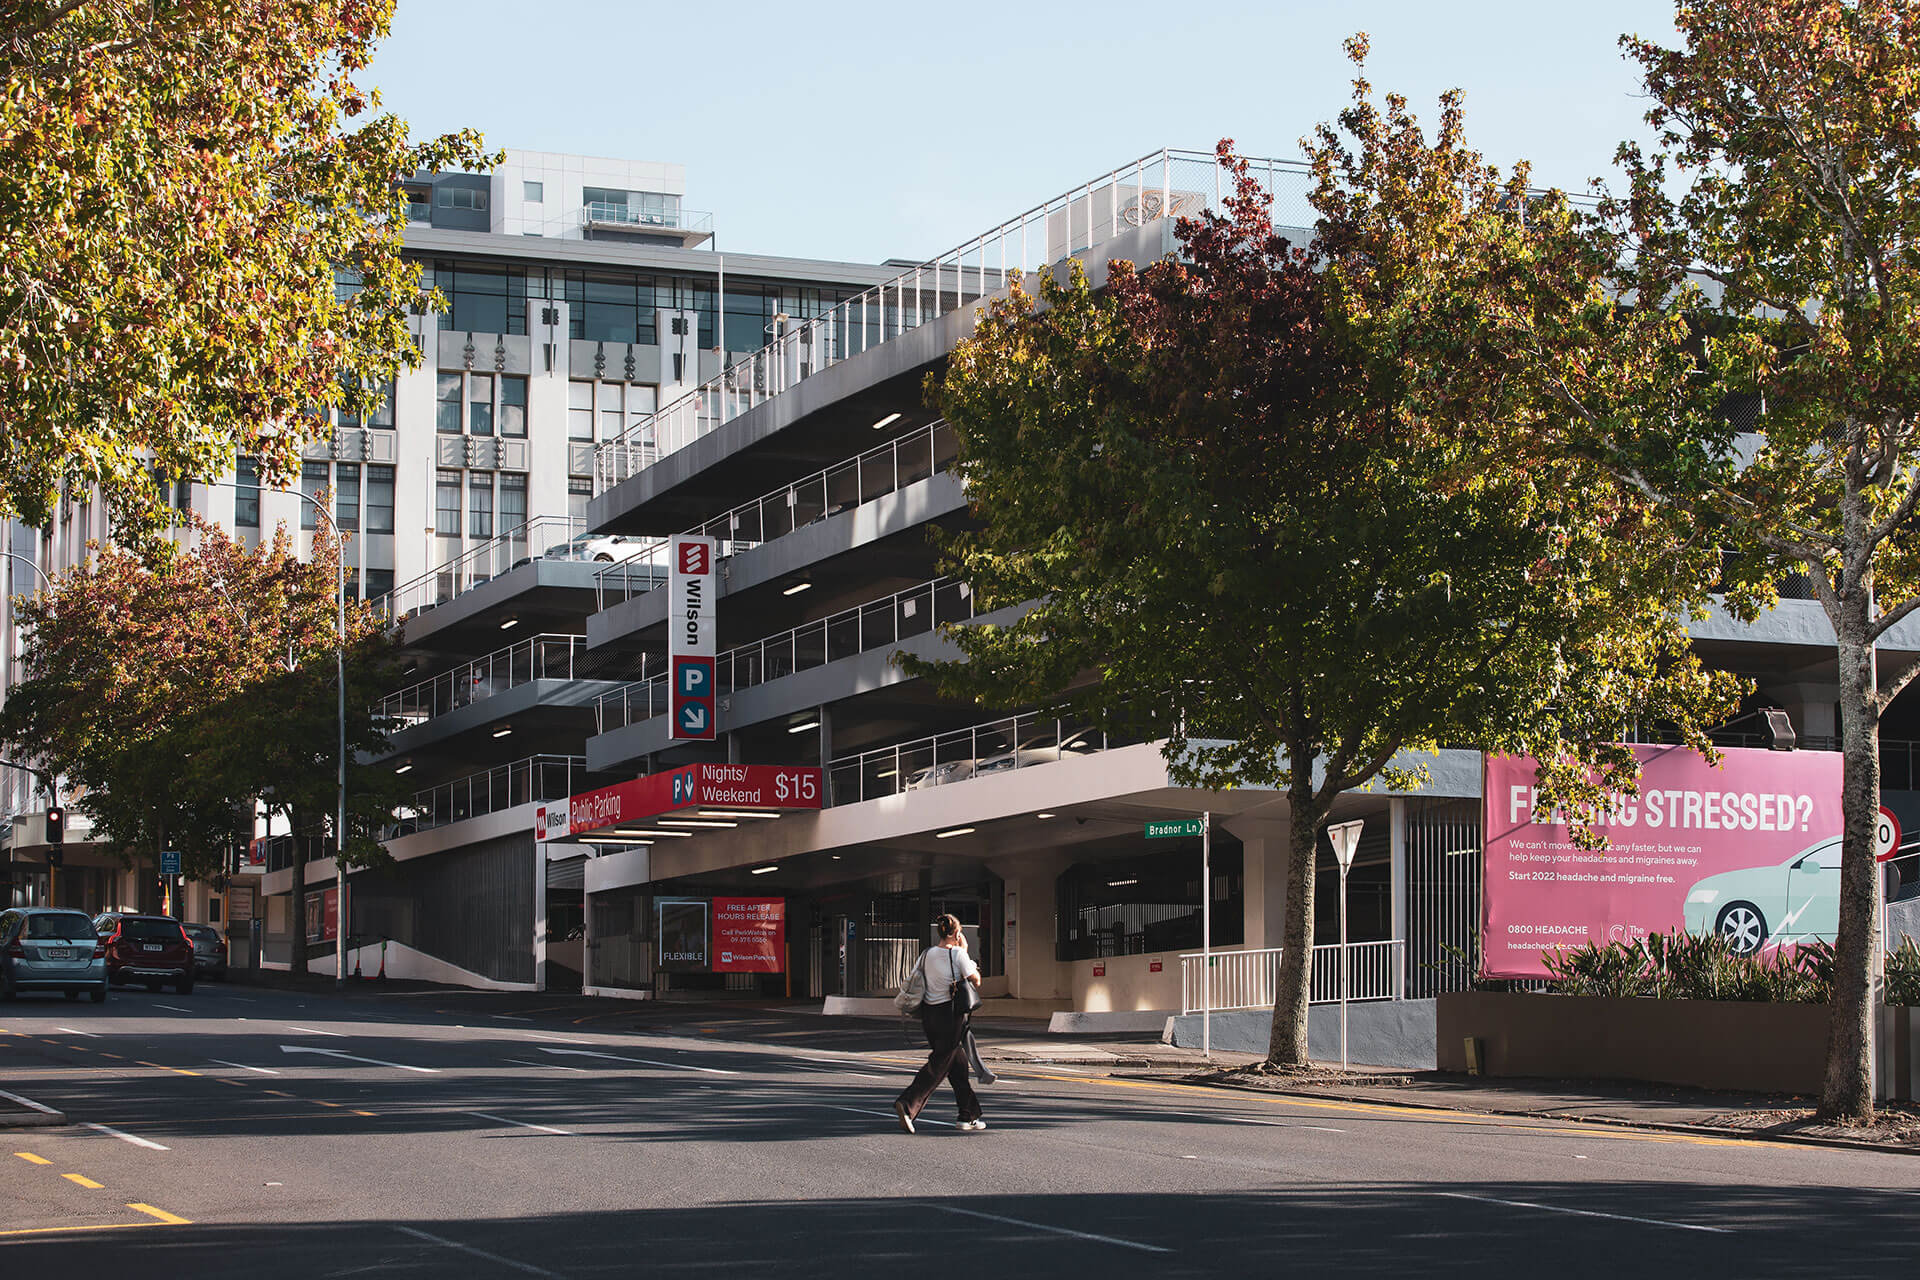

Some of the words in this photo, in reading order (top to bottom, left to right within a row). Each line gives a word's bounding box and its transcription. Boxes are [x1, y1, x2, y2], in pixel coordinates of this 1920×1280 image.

[686, 578, 702, 646] Wilson
[685, 669, 704, 691] P
[702, 765, 748, 782] Nights/
[674, 779, 682, 799] P
[702, 786, 761, 803] Weekend
[775, 772, 816, 801] $15
[571, 800, 593, 826] Public
[594, 792, 621, 819] Parking
[1645, 789, 1814, 832] STRESSED?
[546, 811, 567, 828] Wilson
[1149, 825, 1181, 836] Bradnor
[1186, 823, 1197, 833] Ln
[1510, 840, 1525, 849] We
[1549, 842, 1572, 850] move
[1616, 843, 1630, 852] any
[1631, 843, 1656, 854] faster,
[1658, 844, 1673, 853] but
[1509, 852, 1528, 862] help
[1530, 853, 1550, 864] keep
[1552, 855, 1571, 864] your
[1573, 855, 1617, 864] headaches
[1619, 856, 1634, 864] and
[1636, 856, 1675, 866] migraines
[1676, 859, 1699, 867] away.
[1509, 871, 1531, 881] Start
[1532, 871, 1555, 881] 2022
[1557, 872, 1598, 882] headache
[1600, 873, 1616, 882] and
[1618, 874, 1655, 884] migraine
[1656, 874, 1676, 884] free.
[726, 904, 746, 912] FREE
[747, 904, 771, 912] AFTER
[1507, 925, 1533, 934] 0800
[1535, 926, 1588, 934] HEADACHE
[1629, 925, 1645, 935] The
[663, 952, 703, 961] FLEXIBLE
